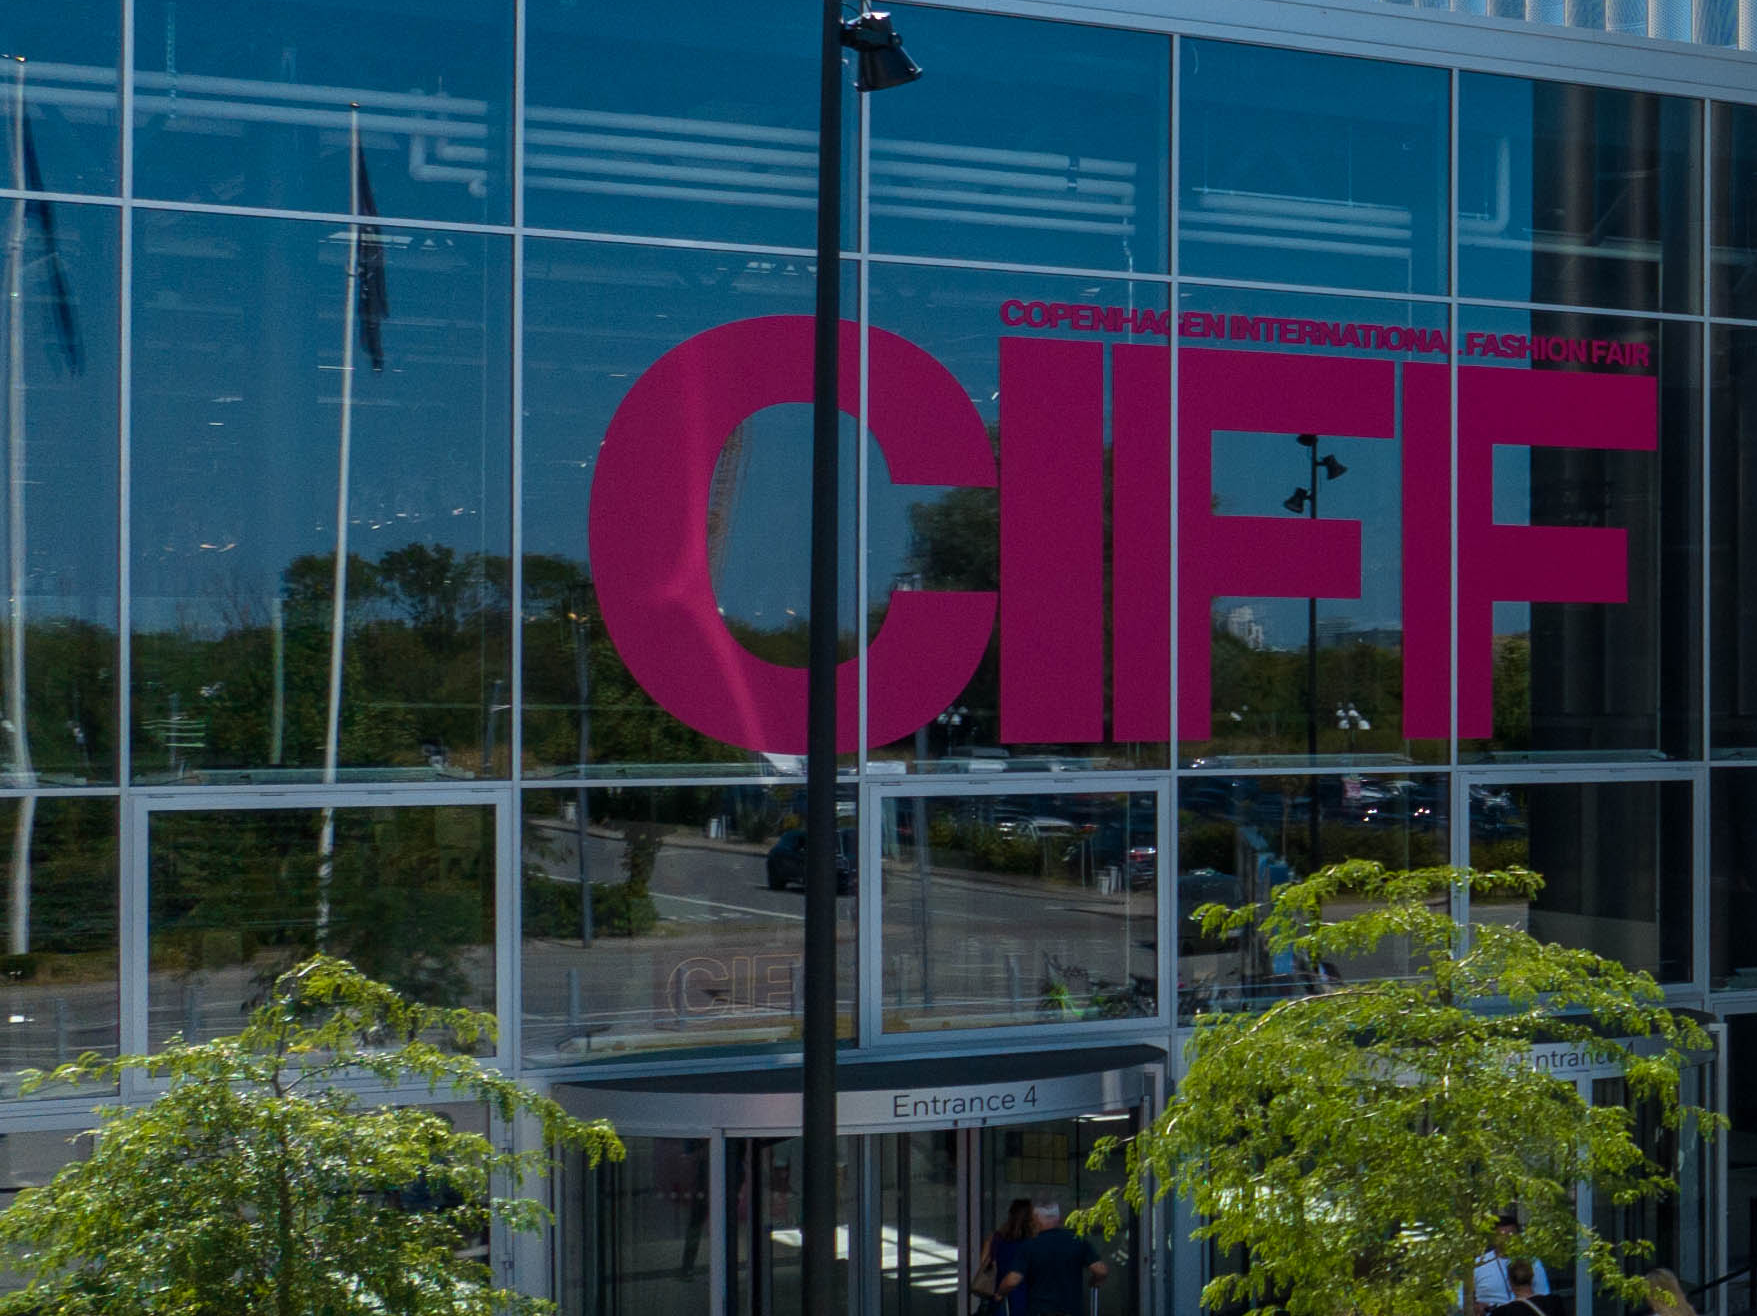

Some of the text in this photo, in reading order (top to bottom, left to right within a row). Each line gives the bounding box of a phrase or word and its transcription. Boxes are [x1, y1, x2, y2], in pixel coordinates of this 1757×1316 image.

[1000, 299, 1225, 339] COPENHAGEN
[1466, 332, 1586, 364] FASHION
[1592, 339, 1649, 366] FAIR
[589, 313, 1658, 753] CIFF
[893, 1084, 1038, 1118] Entrance 4
